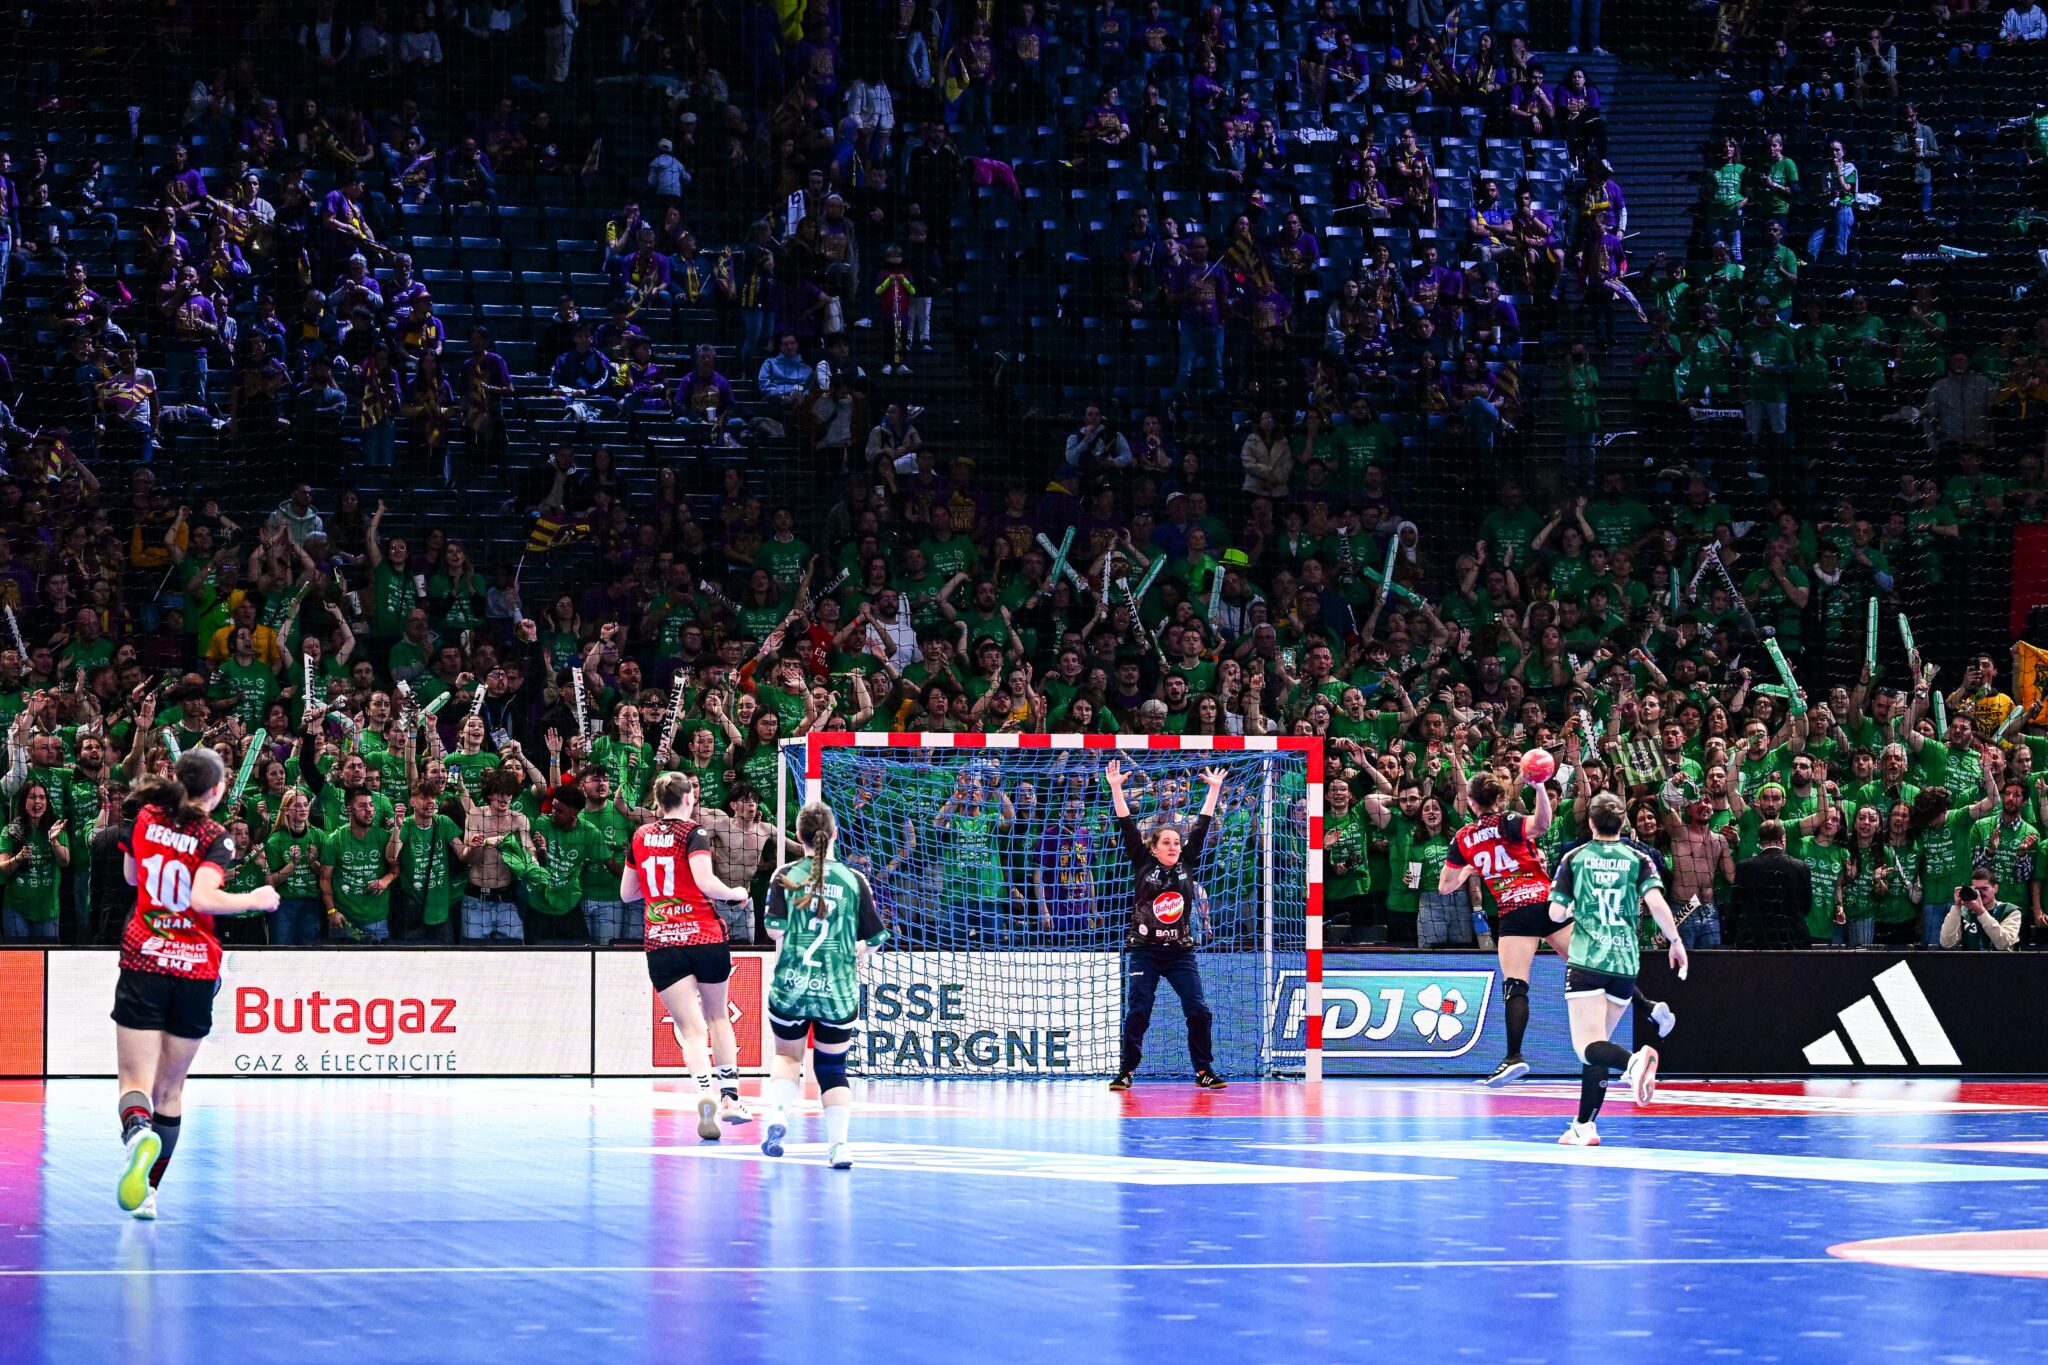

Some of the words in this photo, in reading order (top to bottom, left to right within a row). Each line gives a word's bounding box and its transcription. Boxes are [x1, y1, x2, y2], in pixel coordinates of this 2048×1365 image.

[141, 853, 192, 912] 10
[641, 856, 675, 897] 17
[1473, 845, 1520, 880] 24
[803, 917, 830, 968] 2
[235, 986, 457, 1046] Butagaz
[858, 983, 965, 1022] ISSE
[234, 1054, 284, 1072] GAZ
[295, 1054, 309, 1072] &
[320, 1050, 457, 1072] ÉLECTRICITÉ
[847, 1030, 1071, 1067] EPARGNE
